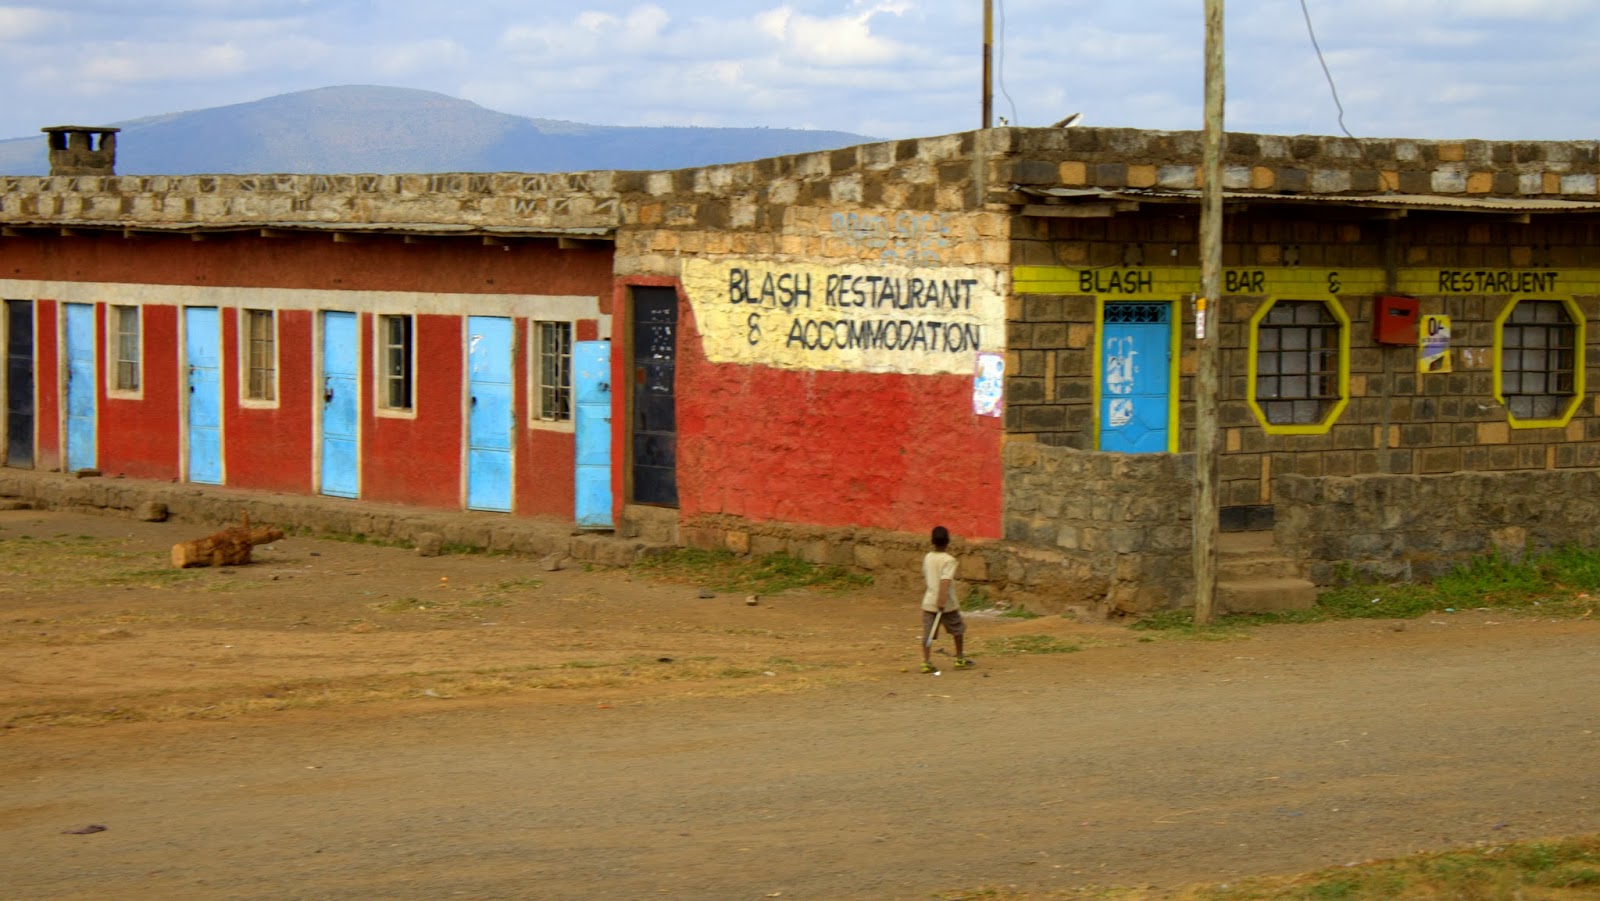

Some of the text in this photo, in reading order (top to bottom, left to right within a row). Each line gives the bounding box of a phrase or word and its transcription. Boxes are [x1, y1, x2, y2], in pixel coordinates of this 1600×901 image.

[730, 268, 978, 309] BLASH RESTAURANT
[1079, 270, 1558, 294] BLASH BAR & RESTARUENT
[747, 312, 980, 352] & ACCOMMODATION
